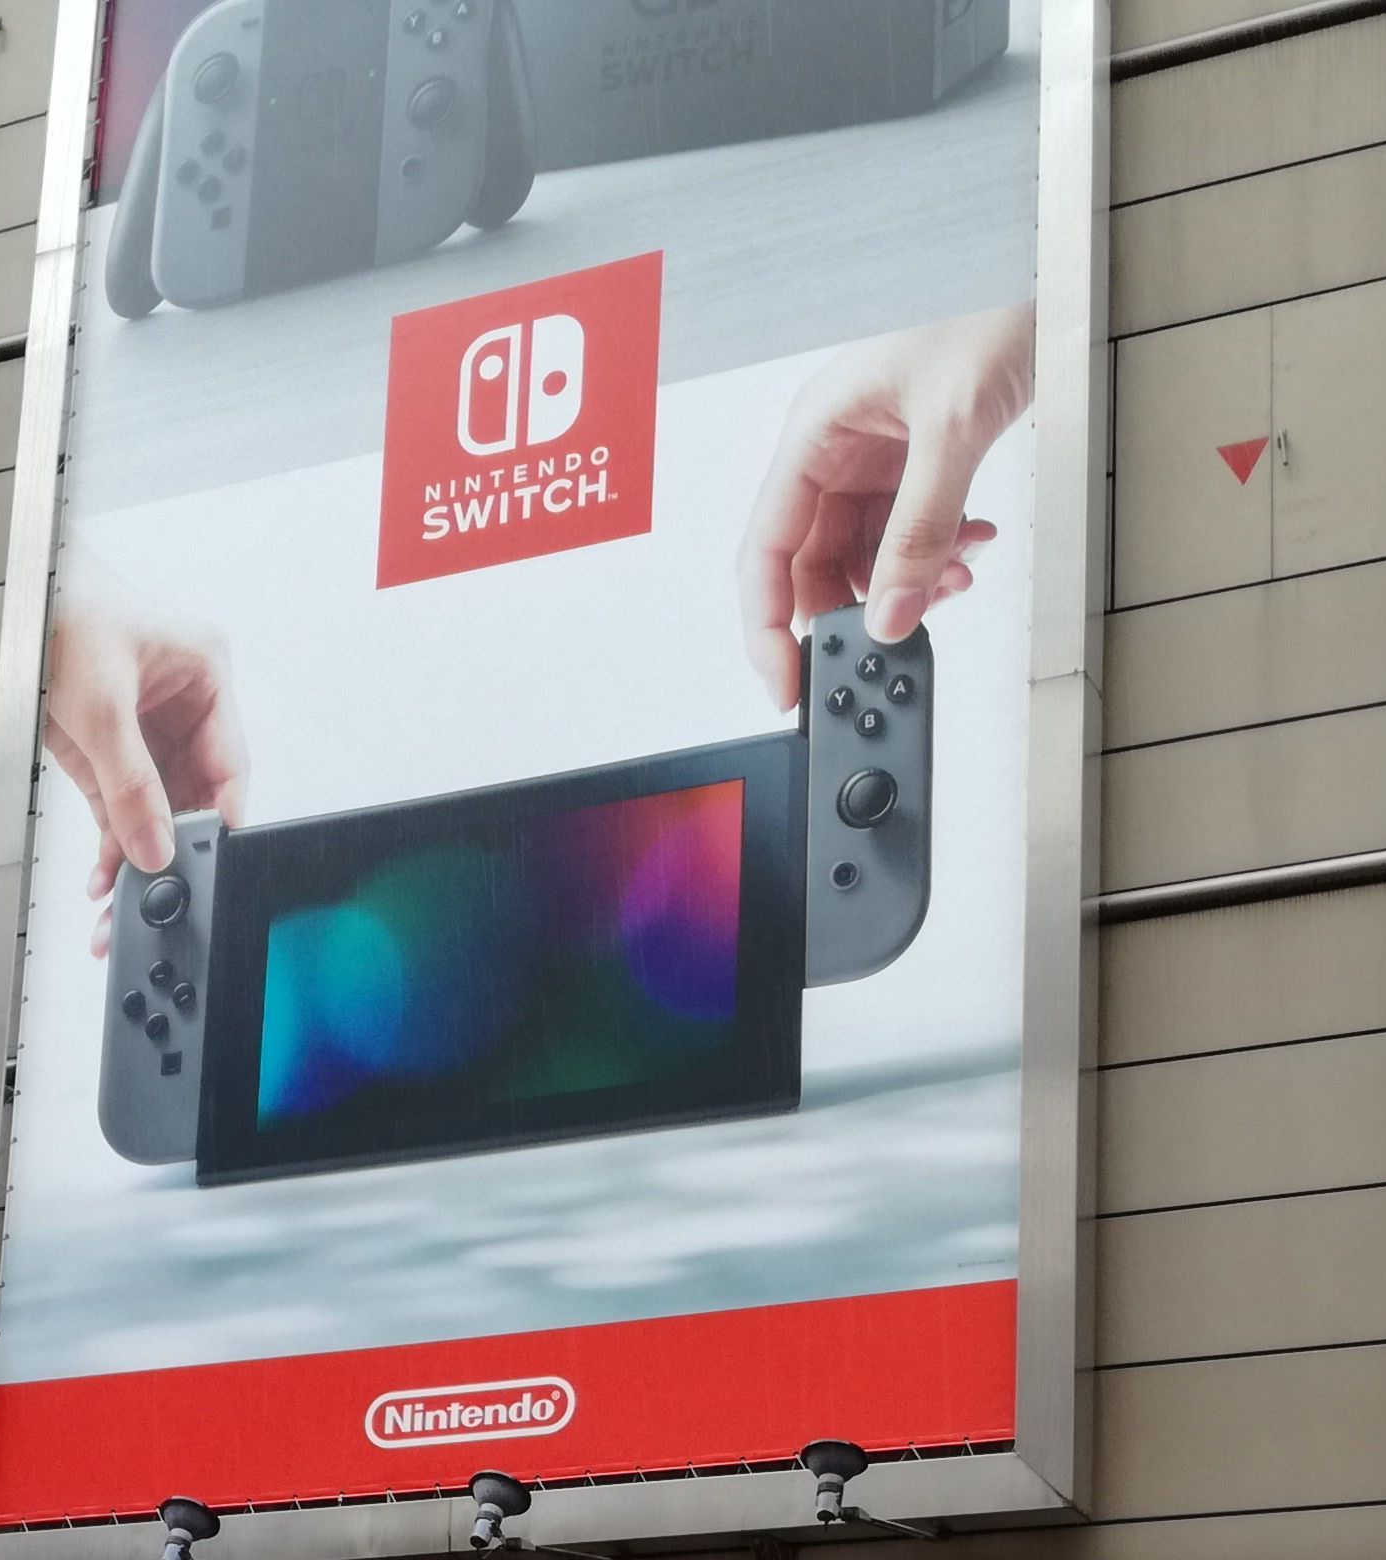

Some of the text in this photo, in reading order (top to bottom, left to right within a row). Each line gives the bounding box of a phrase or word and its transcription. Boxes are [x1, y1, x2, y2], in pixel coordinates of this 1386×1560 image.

[425, 446, 609, 503] NINTENDO
[421, 469, 607, 540] SWITCH
[865, 659, 876, 672] X
[894, 680, 906, 694] A
[834, 691, 846, 706] Y
[865, 714, 875, 728] B
[384, 1392, 555, 1434] Nintendo
